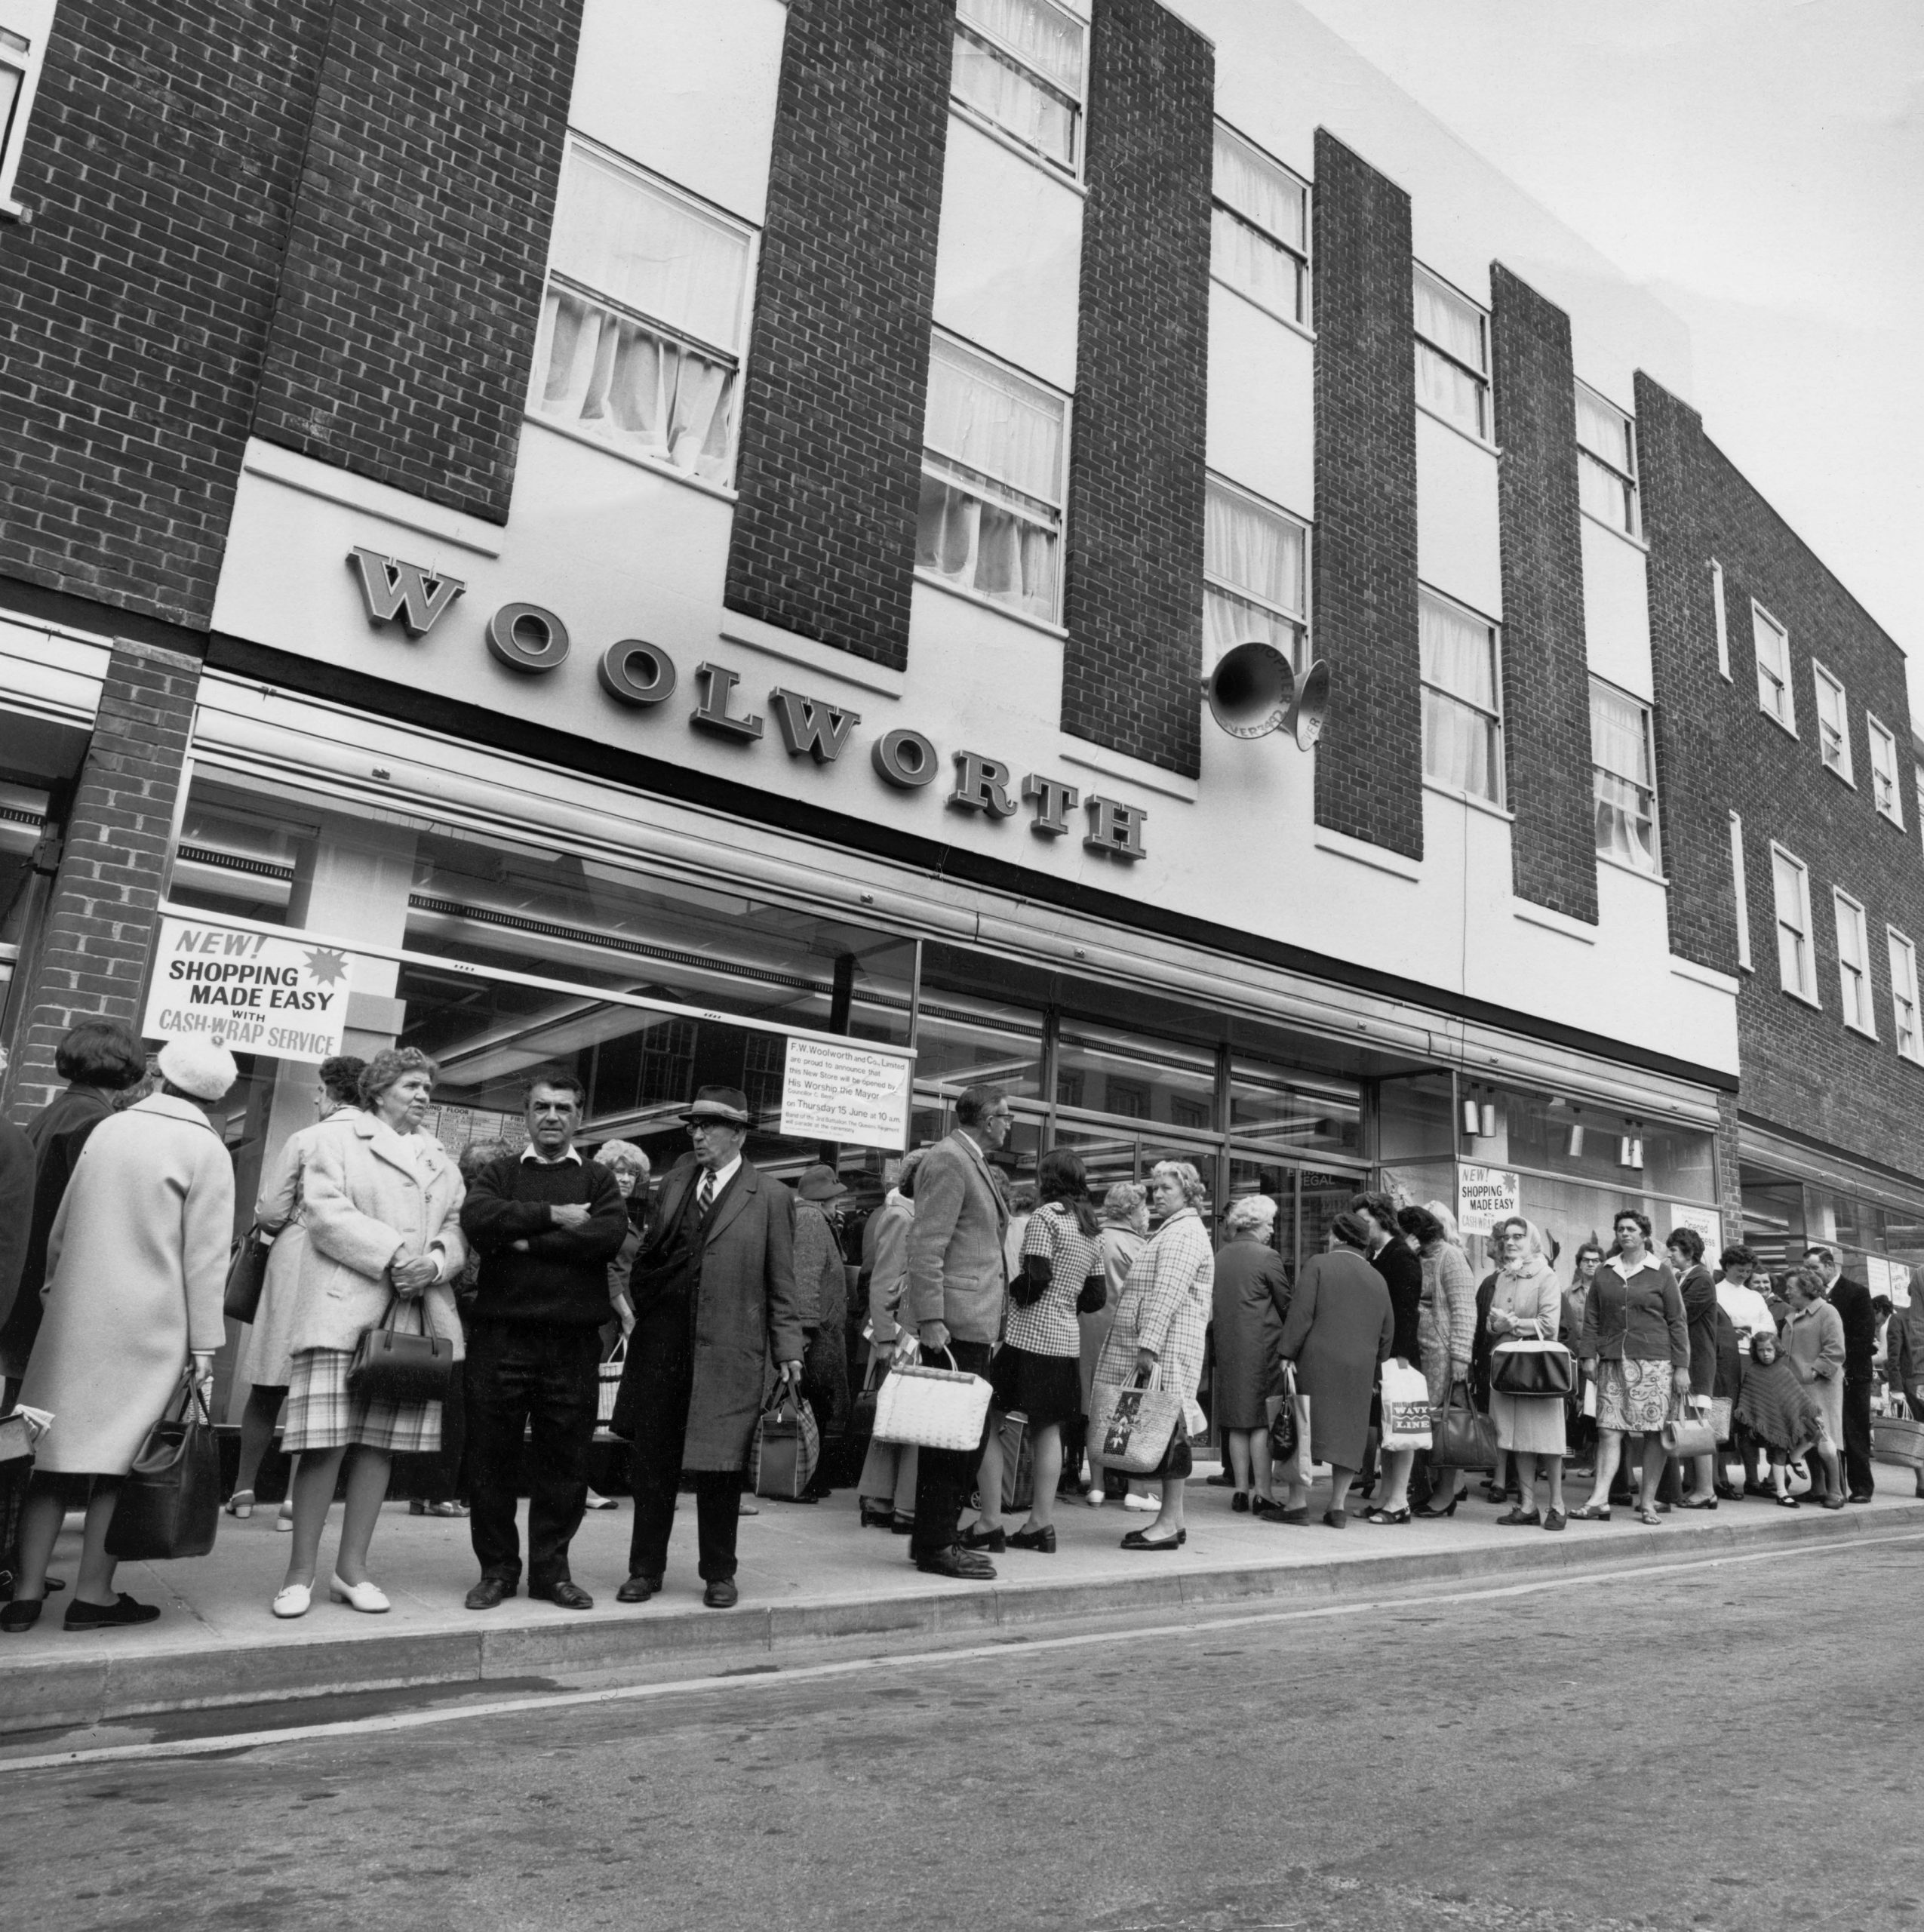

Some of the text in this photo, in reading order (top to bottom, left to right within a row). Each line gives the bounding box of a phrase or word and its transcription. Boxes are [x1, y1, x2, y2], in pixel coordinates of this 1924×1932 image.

[345, 545, 1148, 860] WOOLWORTH
[175, 930, 269, 959] NEW!
[169, 960, 298, 986] SHOPPING
[189, 985, 334, 1011] MADE EASY
[232, 1010, 266, 1023] WITH
[267, 1027, 335, 1056] SERVICE
[834, 1064, 865, 1074] announce
[881, 1058, 905, 1069] Limited
[819, 1071, 838, 1080] Store
[862, 1079, 885, 1088] opened
[788, 1078, 878, 1099] His Worship the Mayor
[446, 1106, 469, 1115] FLOOR
[798, 1099, 835, 1113] Thursday
[838, 1106, 846, 1114] 15
[849, 1108, 868, 1117] June
[878, 1112, 887, 1121] 10
[1462, 1168, 1489, 1183] NEW!
[1461, 1186, 1502, 1198] SHOPPING
[1470, 1198, 1514, 1211] MADE EASY
[1396, 1420, 1431, 1429] LINE
